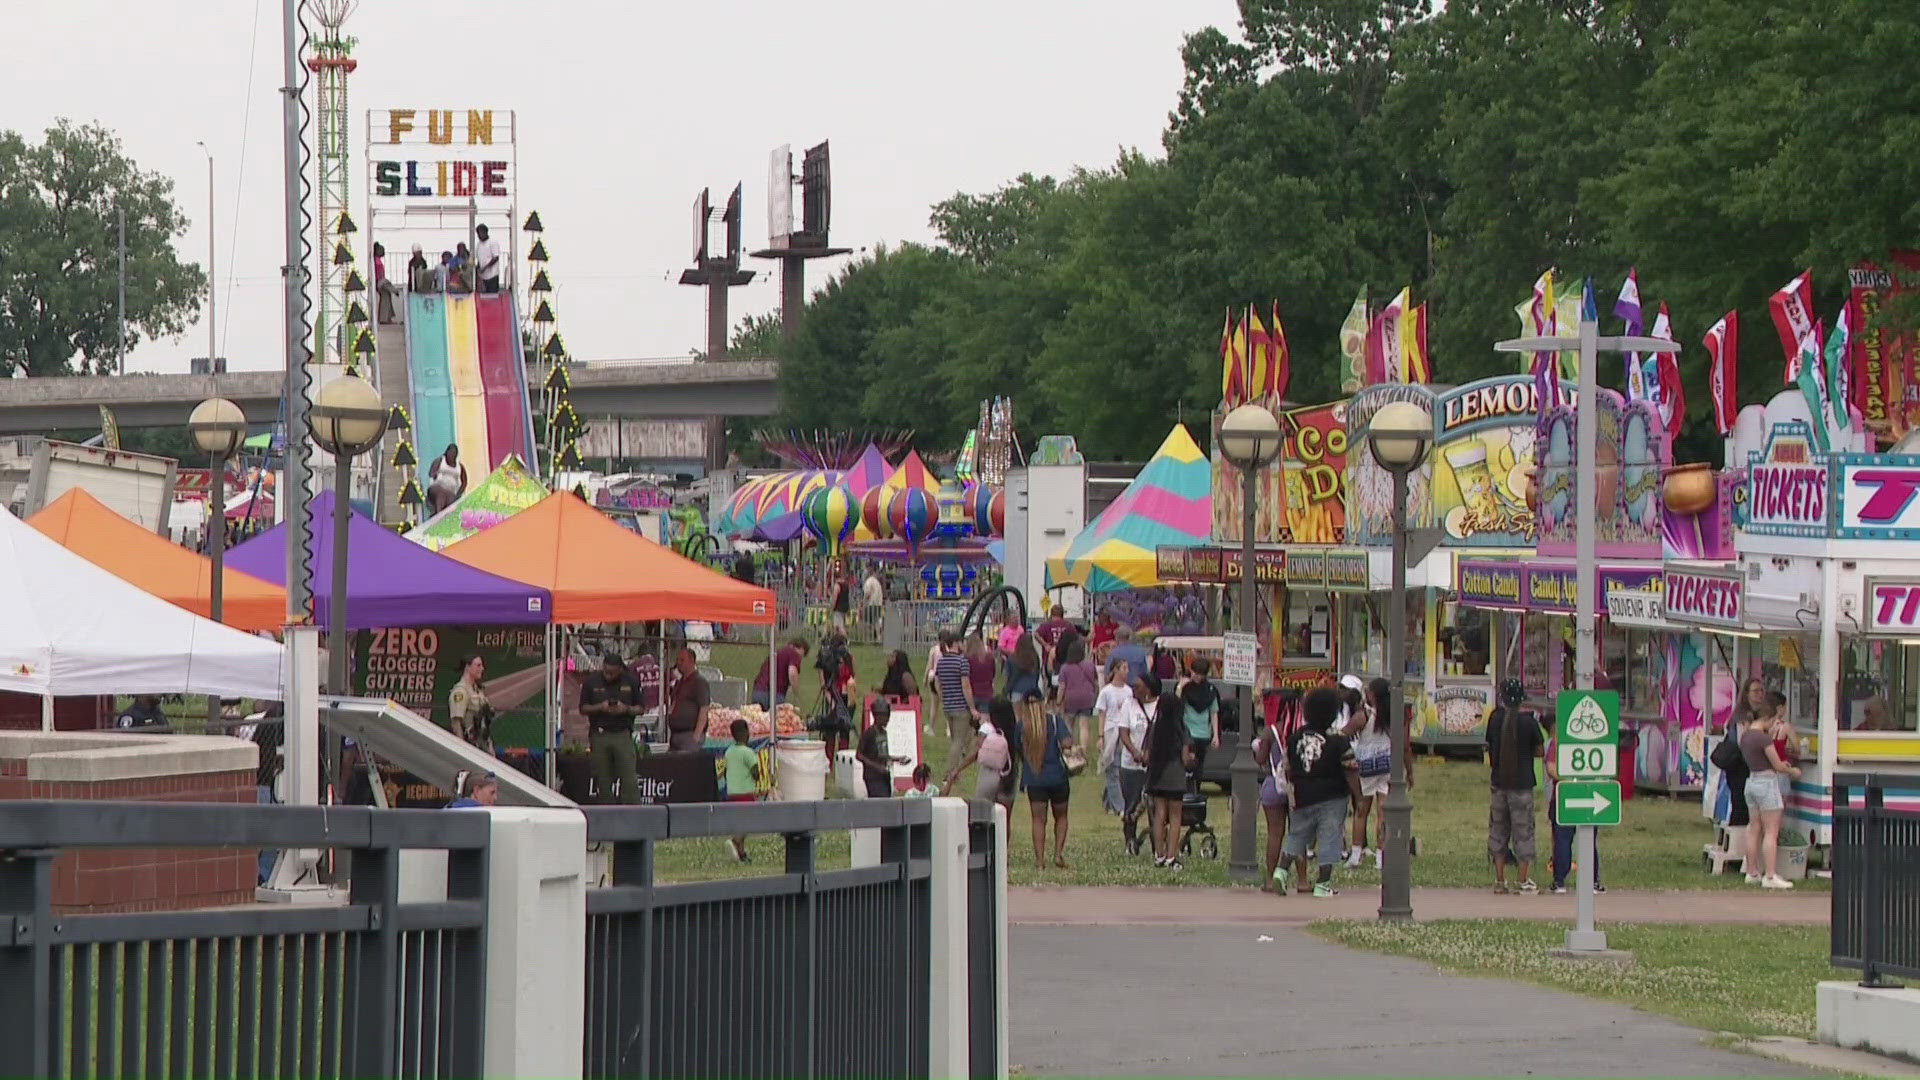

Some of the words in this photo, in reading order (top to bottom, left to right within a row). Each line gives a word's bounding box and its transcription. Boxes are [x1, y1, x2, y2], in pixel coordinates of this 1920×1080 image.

[389, 109, 493, 144] FUN
[376, 160, 507, 196] SLIDE
[1753, 467, 1827, 523] TICKETS
[1459, 512, 1509, 537] Fresh
[1255, 552, 1283, 564] Cold
[1462, 571, 1491, 596] Cotton
[1492, 573, 1520, 601] Candy
[1530, 574, 1560, 605] Candy
[1667, 573, 1741, 618] TICKETS
[1609, 597, 1644, 617] SOUVENIR
[368, 629, 438, 656] ZERO
[476, 630, 505, 646] Leaf
[367, 656, 436, 672] CLOGGED
[365, 674, 435, 690] GUTTERS
[1571, 748, 1604, 771] 80
